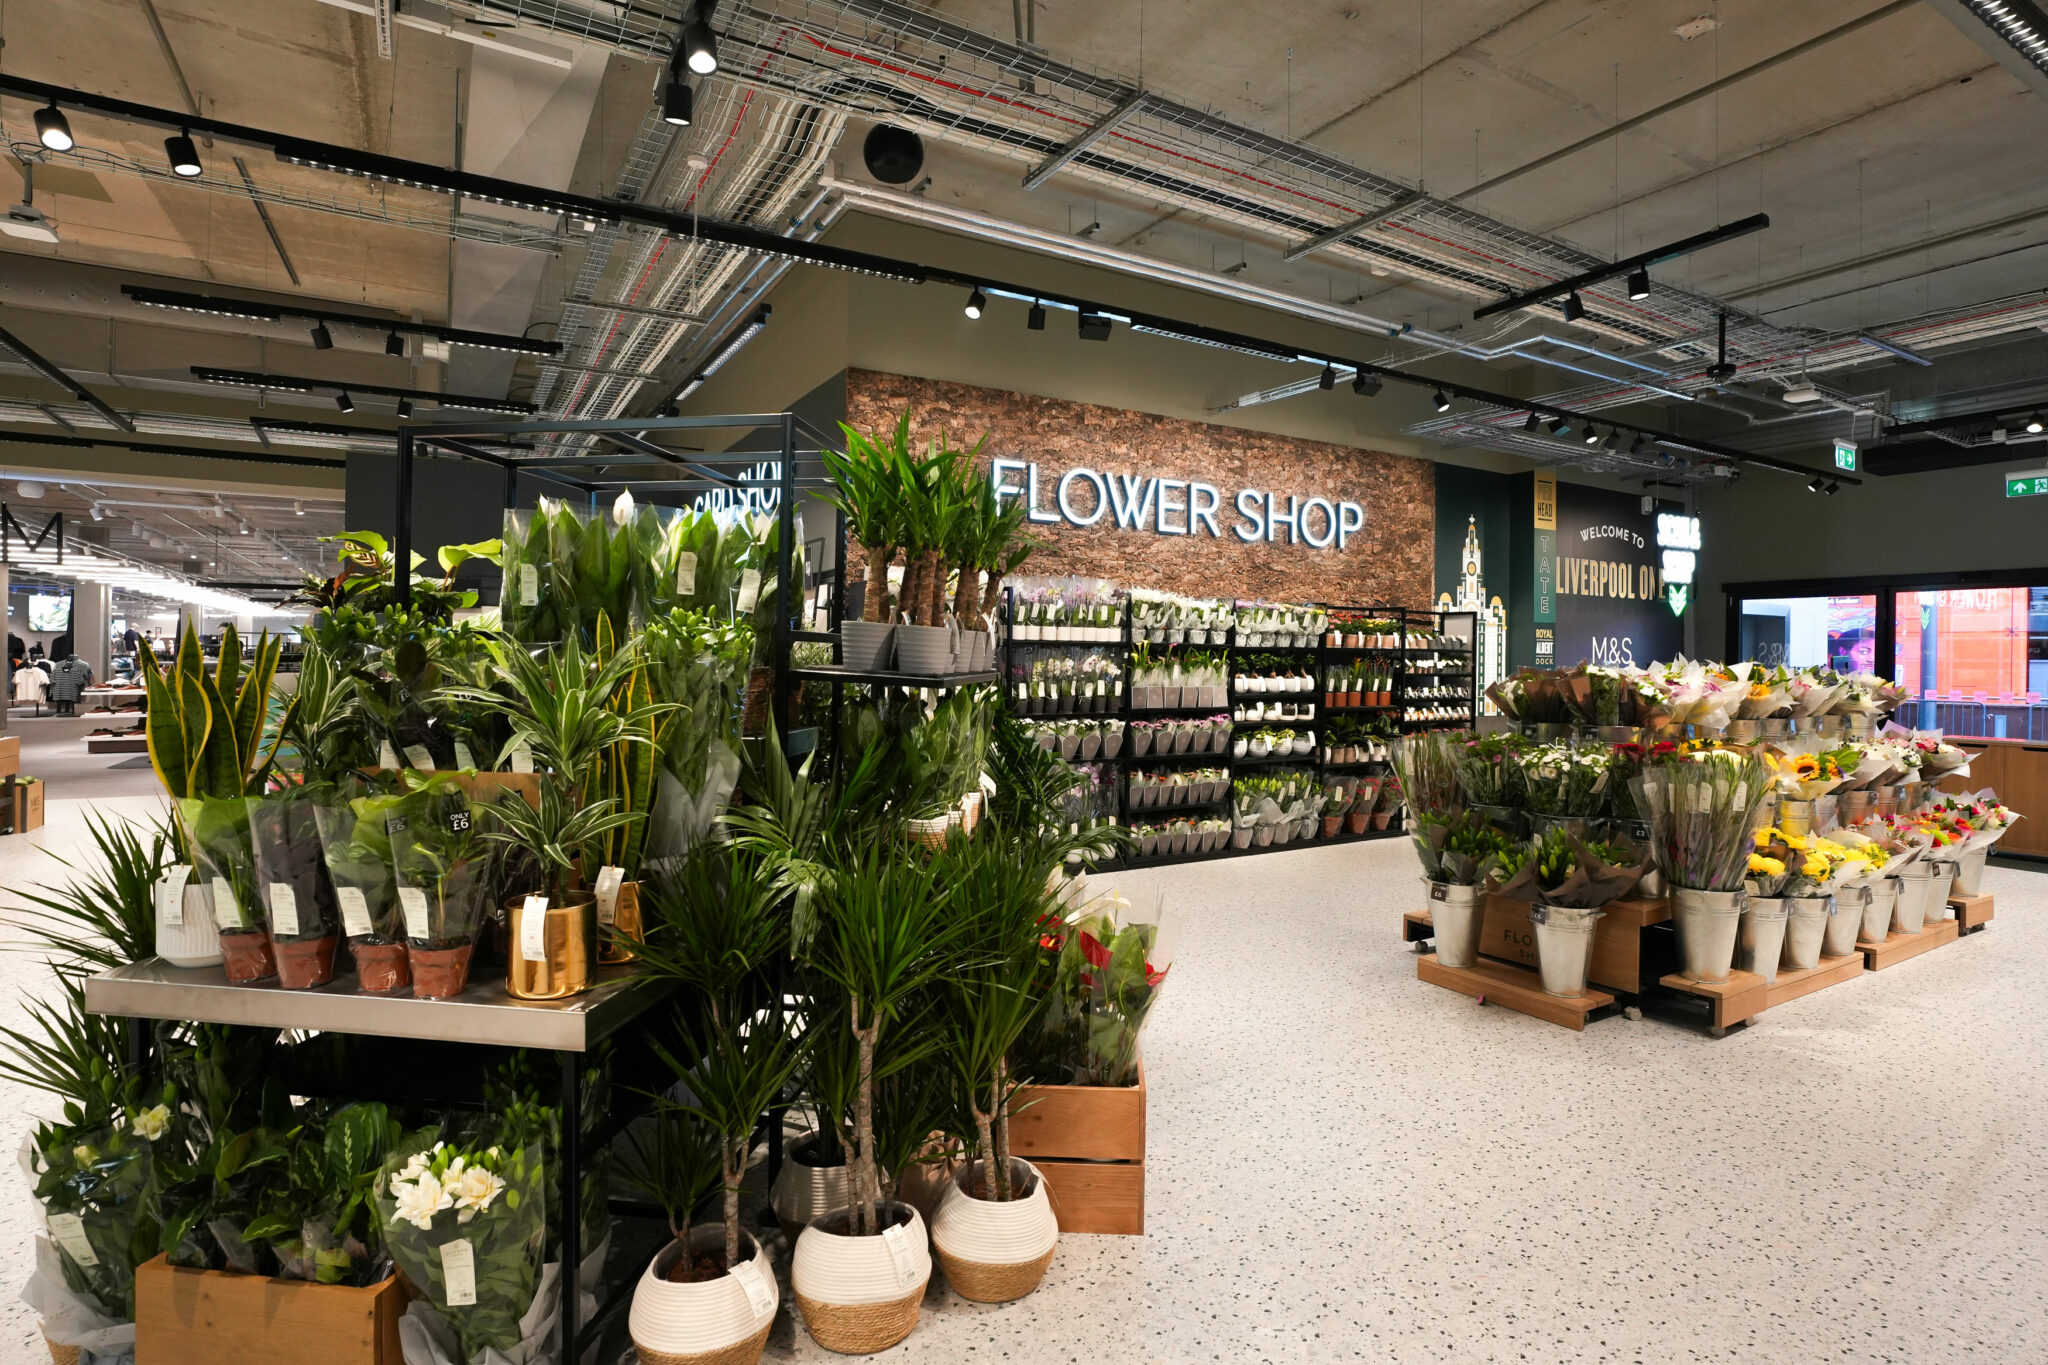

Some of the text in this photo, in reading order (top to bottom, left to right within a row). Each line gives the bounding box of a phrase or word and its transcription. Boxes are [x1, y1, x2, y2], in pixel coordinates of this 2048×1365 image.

[990, 458, 1364, 550] FLOWER SHOP
[1537, 502, 1552, 518] HEAD
[1580, 525, 1645, 549] WELCOME TO
[1540, 535, 1550, 614] TATE
[1555, 556, 1635, 599] LIVERPOOL
[1536, 629, 1553, 638] ROYAL
[1536, 641, 1553, 654] ALBERT
[1592, 636, 1632, 664] M&S
[1536, 657, 1553, 665] DOCK
[450, 811, 470, 821] ONLY
[453, 818, 469, 830] £6
[391, 822, 405, 833] £6
[1504, 929, 1533, 946] FLO
